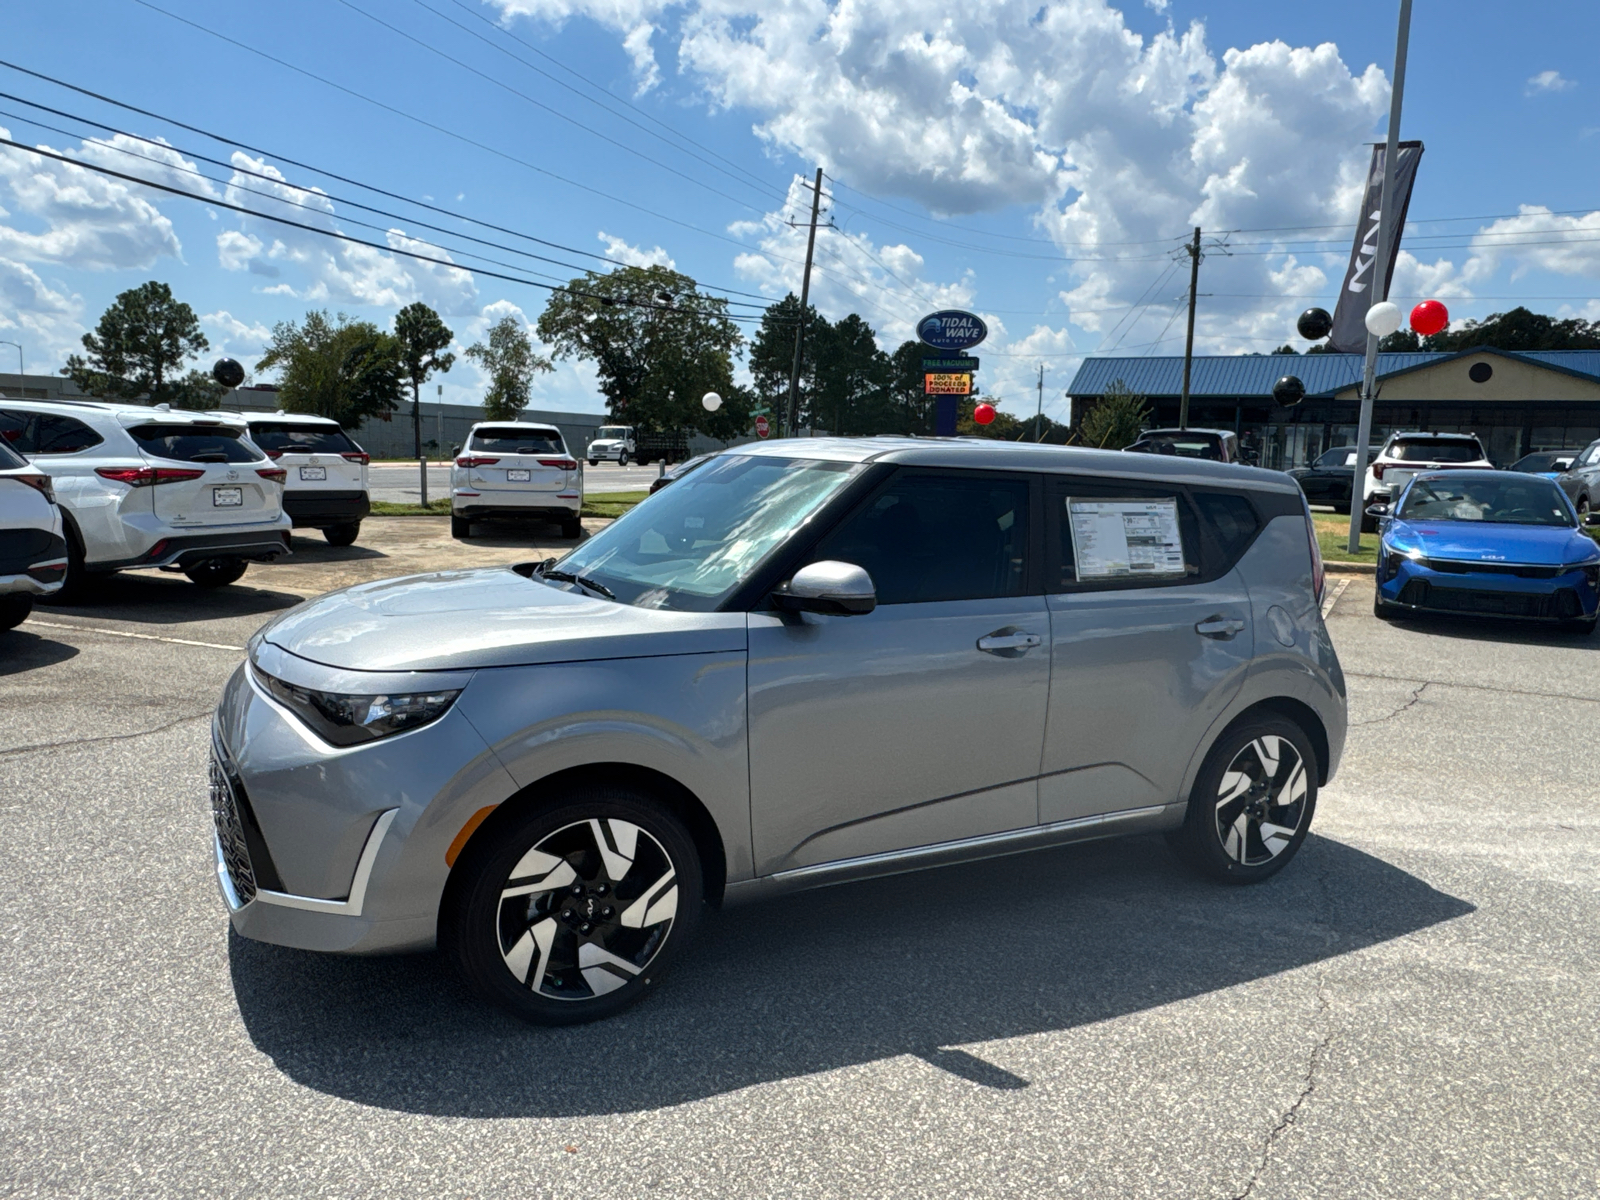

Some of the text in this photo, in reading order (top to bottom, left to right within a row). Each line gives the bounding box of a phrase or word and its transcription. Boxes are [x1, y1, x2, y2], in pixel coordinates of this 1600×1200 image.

[941, 317, 973, 327] TIDAL
[946, 328, 980, 338] WAVE
[756, 422, 769, 432] STOP
